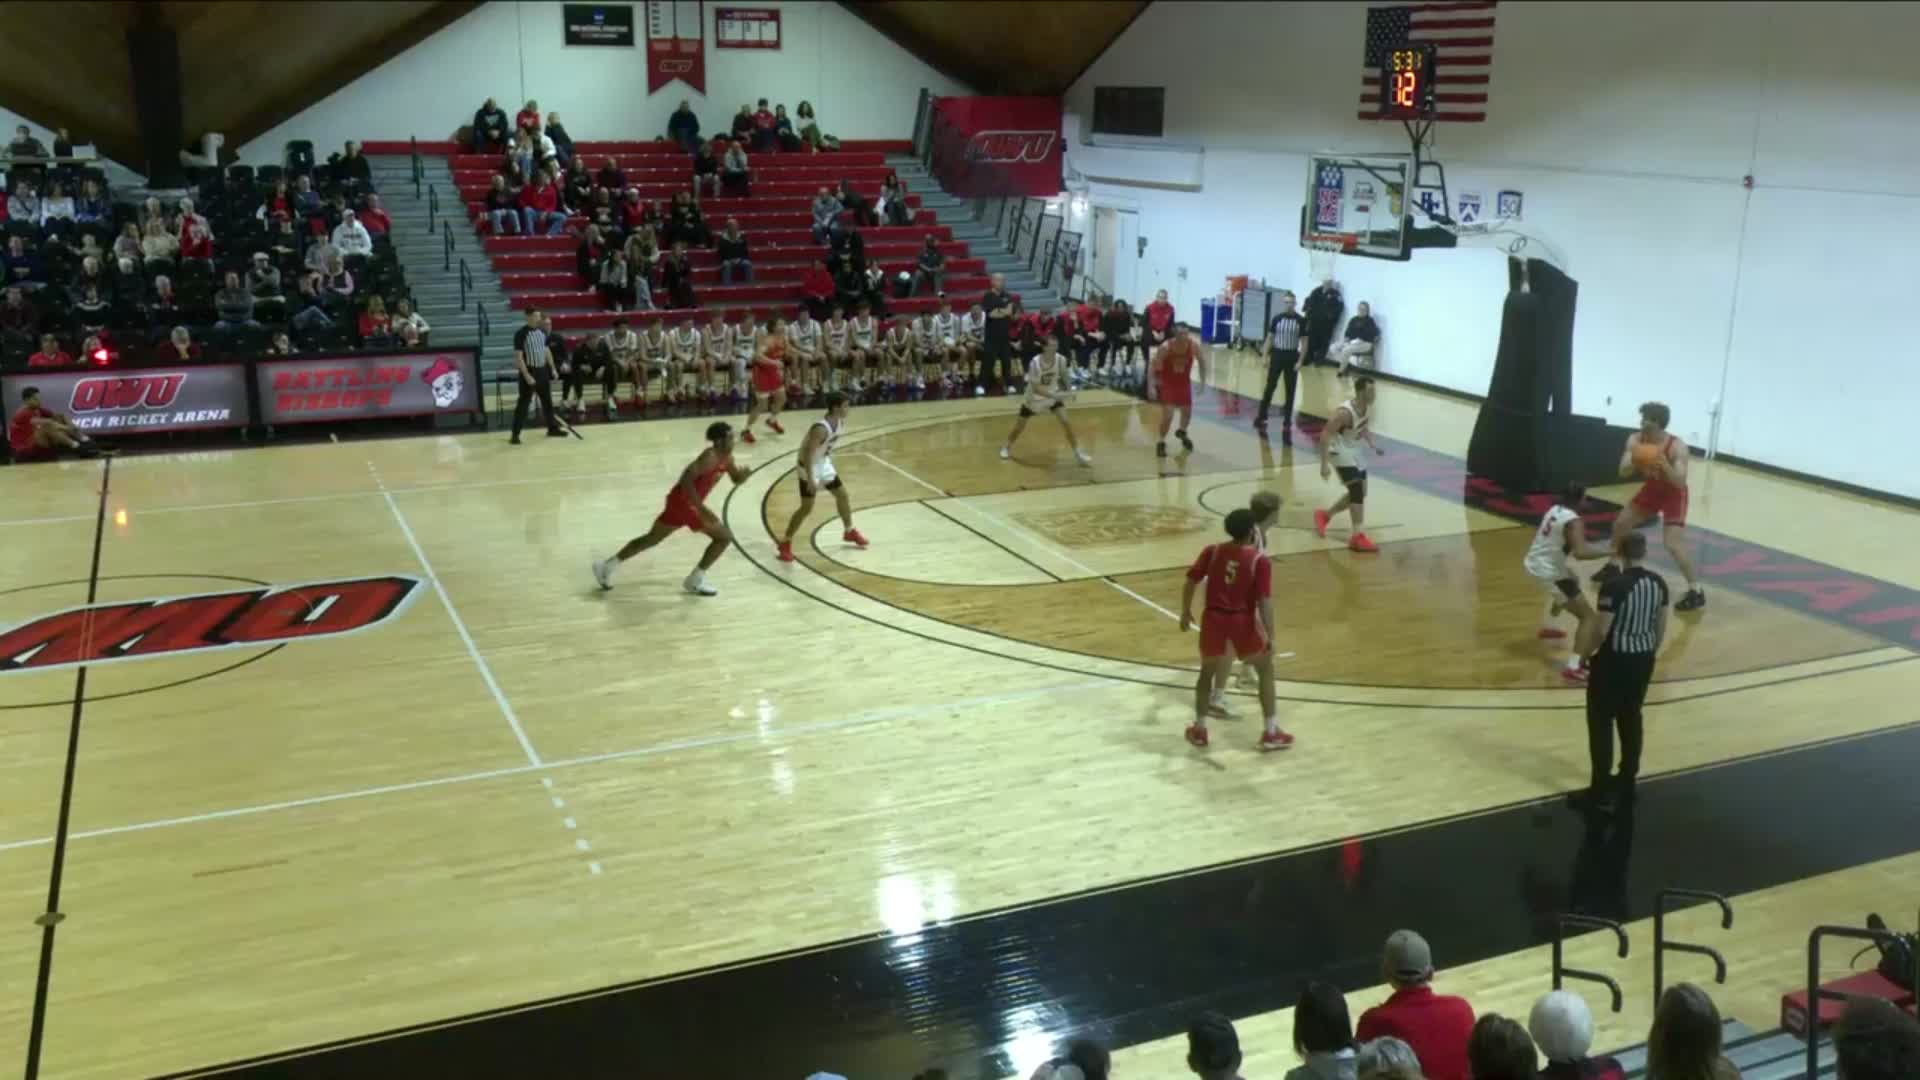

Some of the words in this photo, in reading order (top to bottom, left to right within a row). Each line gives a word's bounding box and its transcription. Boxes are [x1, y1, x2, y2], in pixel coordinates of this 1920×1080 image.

[1392, 51, 1422, 70] 5:31
[1397, 72, 1415, 106] 12
[69, 373, 187, 413] OWU
[108, 413, 169, 427] RICKEY
[173, 409, 231, 422] ARENA
[1224, 559, 1240, 585] 5
